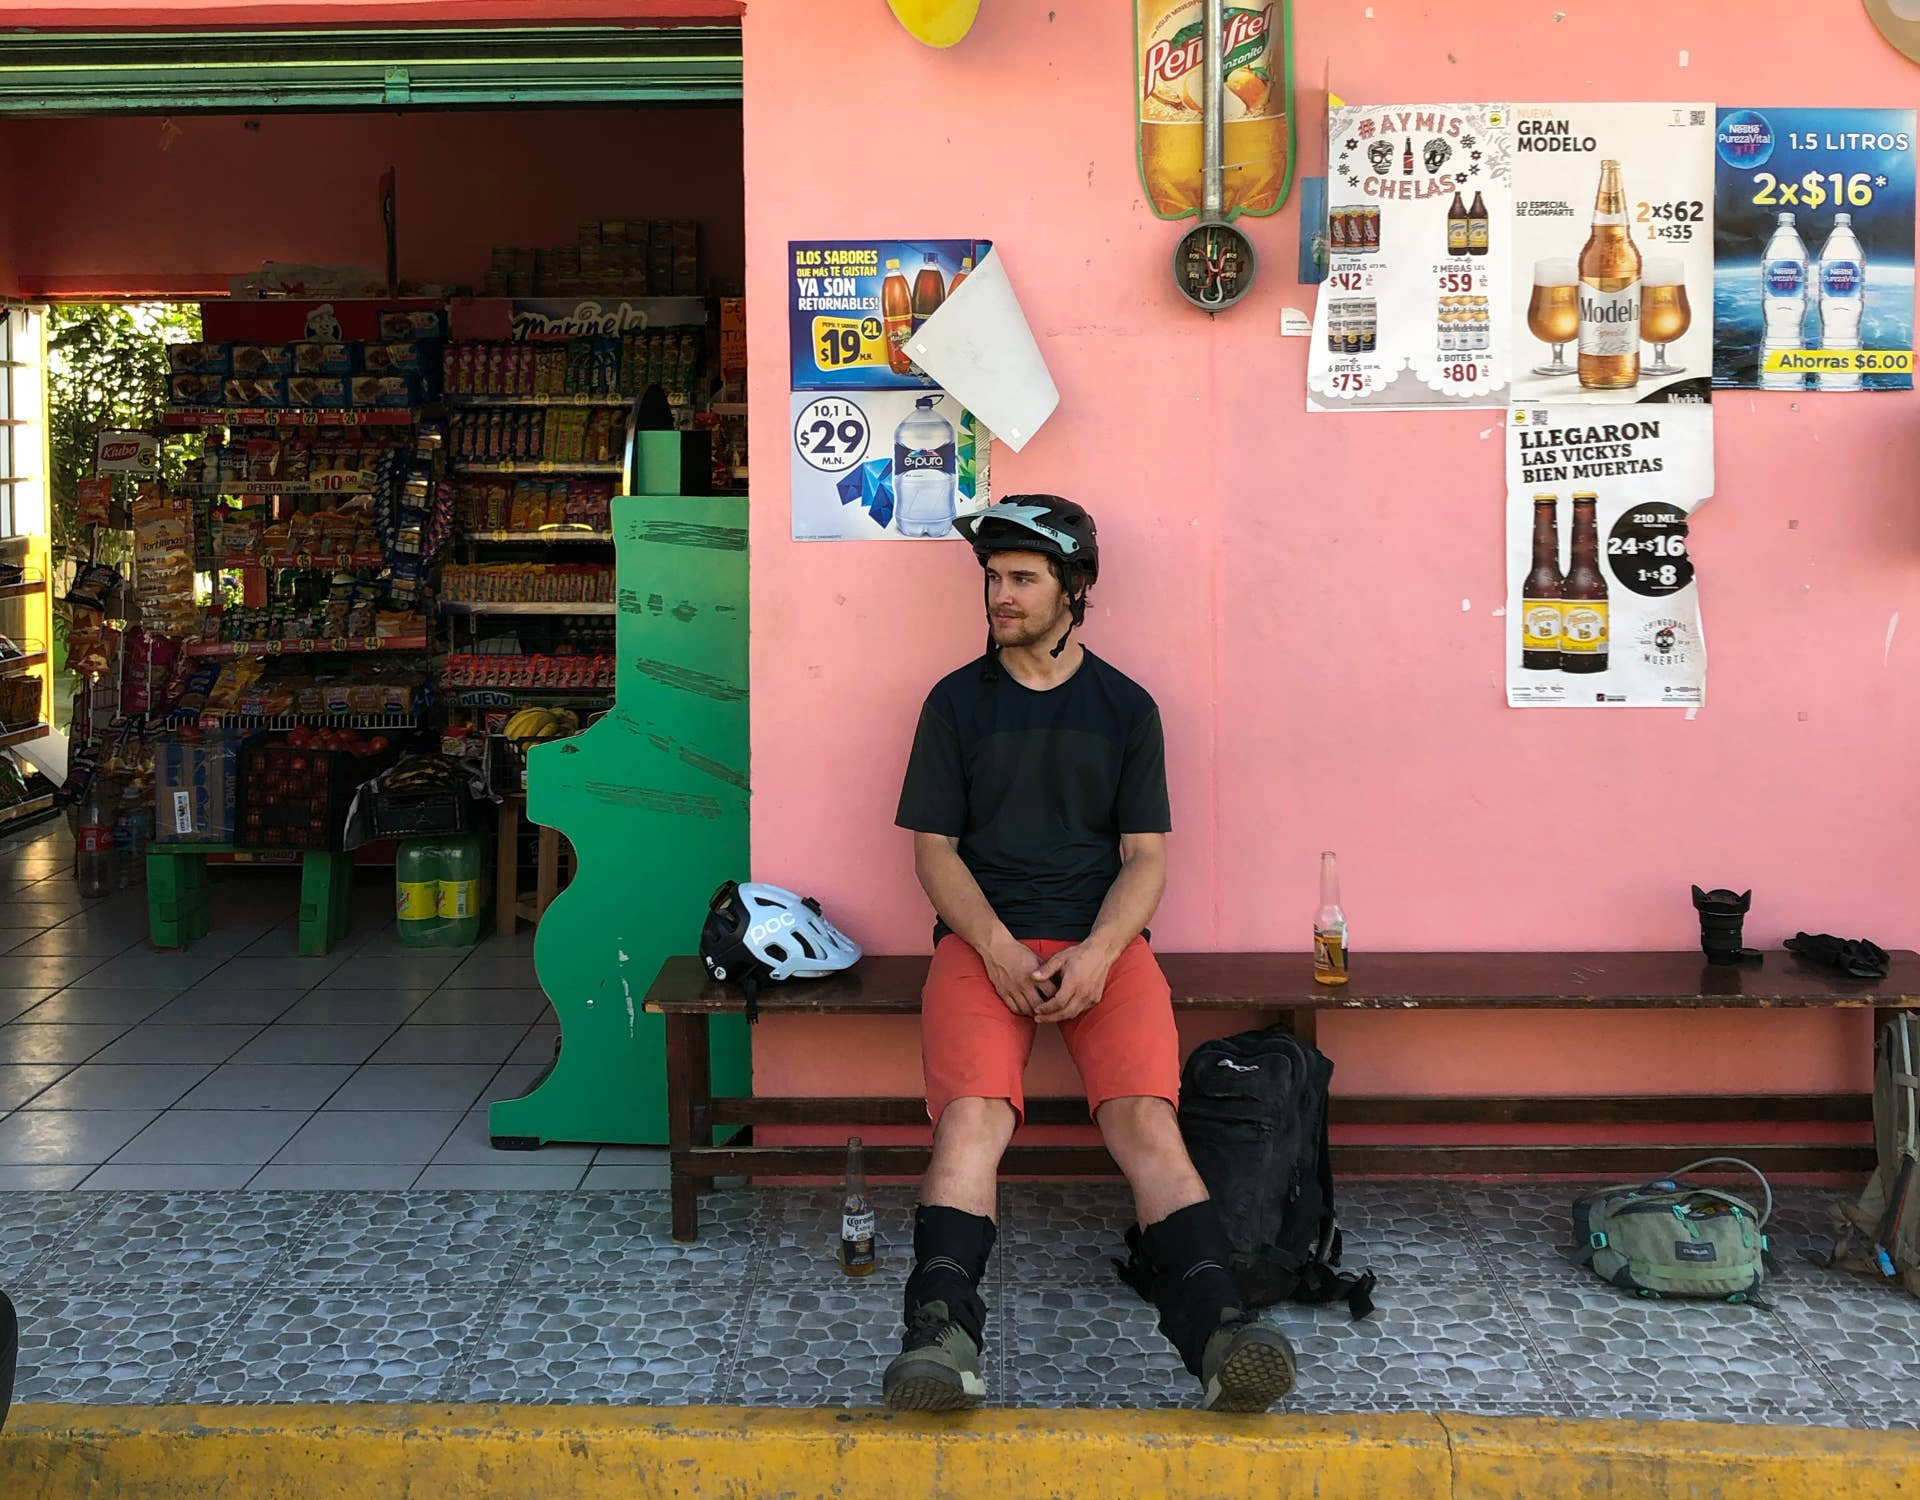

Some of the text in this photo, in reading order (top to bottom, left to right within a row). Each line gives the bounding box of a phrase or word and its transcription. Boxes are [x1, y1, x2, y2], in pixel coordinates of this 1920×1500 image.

[1145, 3, 1273, 97] Peñfiel
[1223, 45, 1263, 69] nzanita
[1358, 112, 1463, 140] #AYMIS
[1517, 120, 1569, 135] GRAN
[1517, 137, 1597, 152] MODELO
[1789, 133, 1909, 150] 1.5 LITROS
[1363, 174, 1457, 199] CHELAS
[1636, 201, 1704, 223] 2x$62
[1647, 225, 1693, 240] 1x$35
[824, 249, 878, 265] SABORES
[796, 265, 877, 277] QUE MÁS TE GUSTAN
[1432, 265, 1439, 273] 2
[1440, 265, 1472, 273] MEGAS
[797, 278, 856, 297] YA SON
[1330, 273, 1362, 291] $42
[1439, 273, 1472, 292] $59
[798, 297, 880, 311] RETORNABLES!
[1581, 297, 1640, 323] Modelo
[513, 305, 644, 341] Marinela
[863, 321, 880, 336] 2L
[821, 329, 861, 365] $19
[1444, 354, 1473, 362] BOTES
[1780, 354, 1908, 370] Ahorras $6.00
[1443, 363, 1477, 382] $80
[1332, 374, 1363, 391] $75
[845, 405, 852, 416] L
[306, 414, 316, 424] 22
[345, 414, 355, 424] 24
[800, 420, 864, 453] $29
[1519, 421, 1660, 449] LLEGARON
[143, 455, 150, 465] 5
[822, 457, 845, 465] M.N.
[1521, 443, 1632, 466] LAS VICKYS
[1523, 457, 1663, 483] BIEN MUERTAS
[247, 483, 282, 492] OFERTA
[1633, 514, 1679, 523] 210 ML
[269, 643, 279, 653] 32
[1644, 653, 1686, 665] MUERTE
[462, 693, 511, 705] NUEVO
[751, 912, 796, 945] POC
